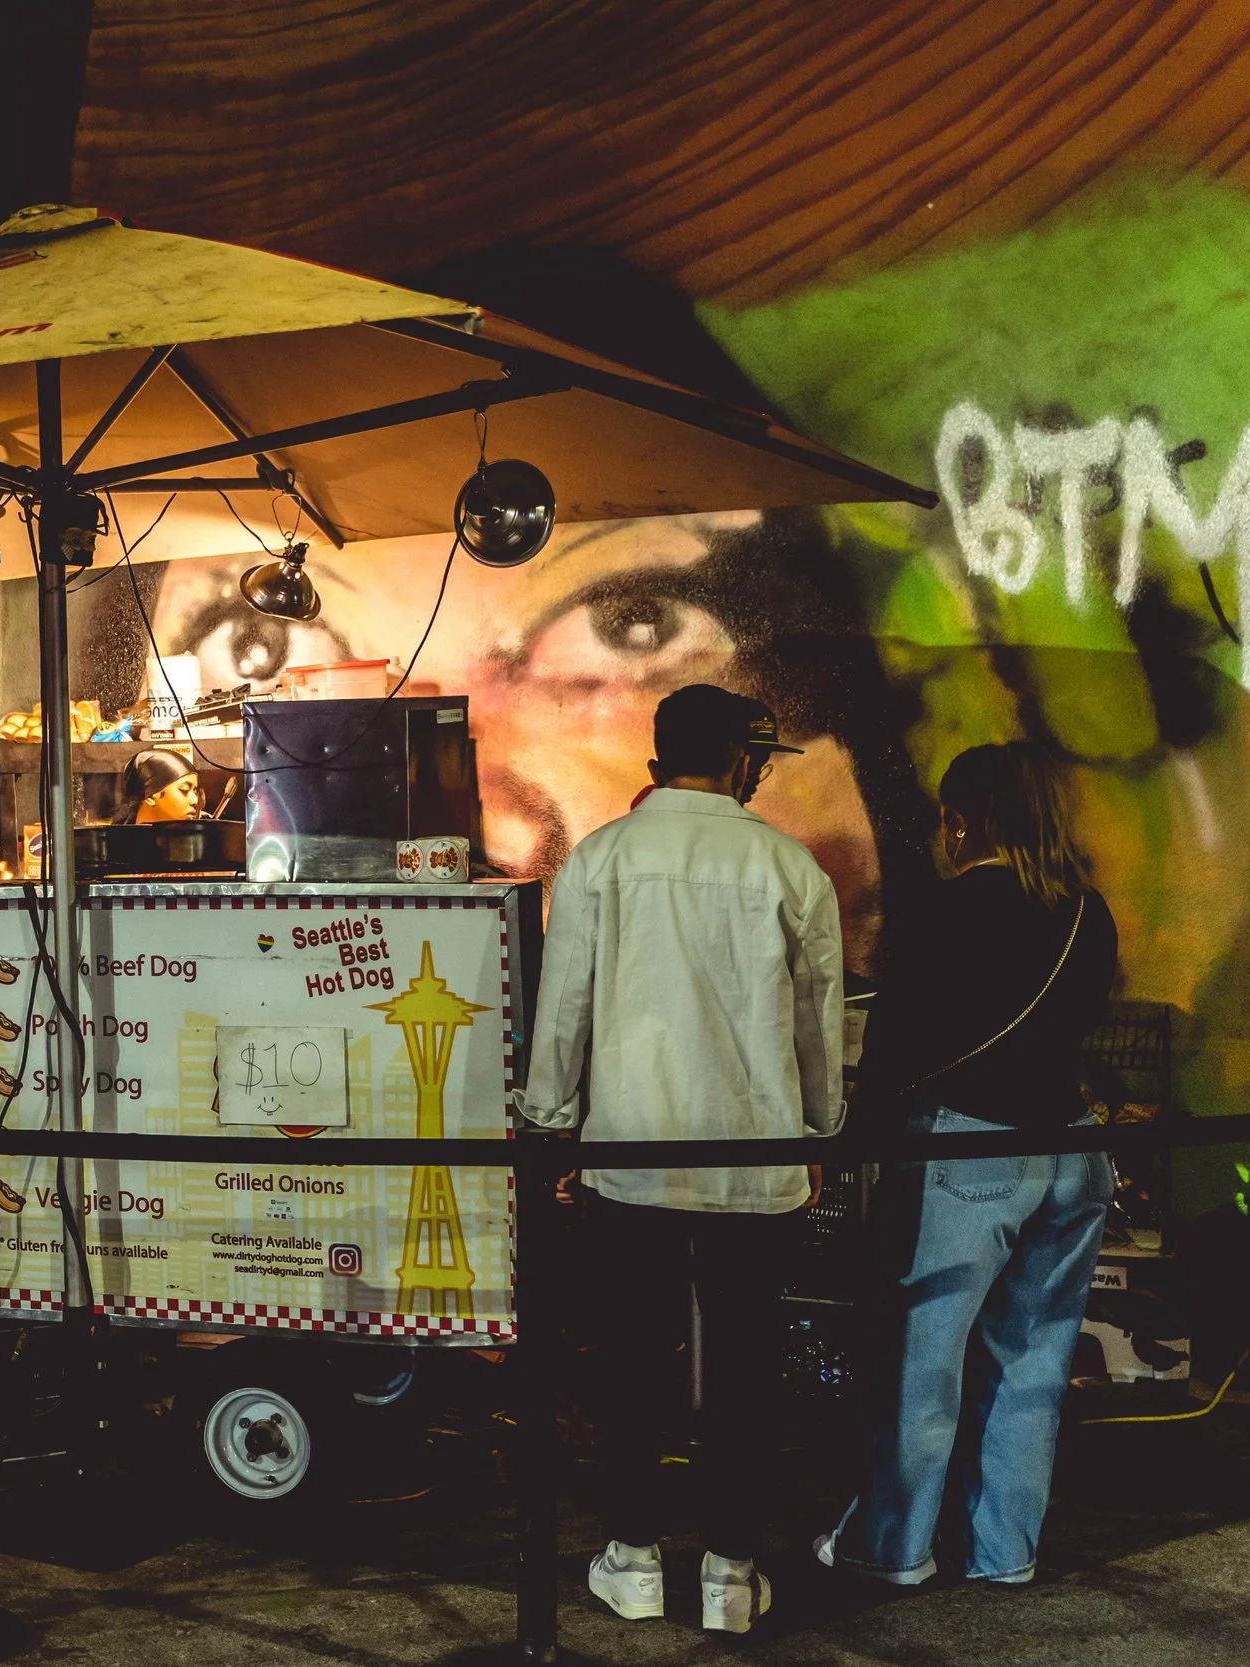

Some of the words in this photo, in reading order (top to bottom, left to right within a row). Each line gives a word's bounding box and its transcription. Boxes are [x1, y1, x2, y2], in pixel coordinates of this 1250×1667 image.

[292, 914, 383, 949] Seattle's
[338, 937, 390, 967] Best
[96, 953, 146, 977] Beef
[150, 955, 197, 983] Dog
[305, 971, 345, 998] Hot
[348, 966, 395, 990] Dog
[32, 1013, 96, 1037] Poh
[102, 1015, 148, 1043] Dog
[235, 1042, 322, 1096] $10
[33, 1070, 91, 1098] Spy
[96, 1072, 142, 1100] Dog
[215, 1172, 274, 1192] Grilled
[278, 1174, 344, 1195] Onions
[118, 1190, 164, 1219] Dog
[7, 1238, 48, 1253] Gluten
[86, 1244, 109, 1256] uns
[112, 1244, 169, 1260] available
[211, 1233, 263, 1249] Catering
[266, 1235, 322, 1251] Available
[212, 1250, 323, 1265] www.dirtydoghotdog.com
[234, 1264, 324, 1279] seadirtyd@gmail.com
